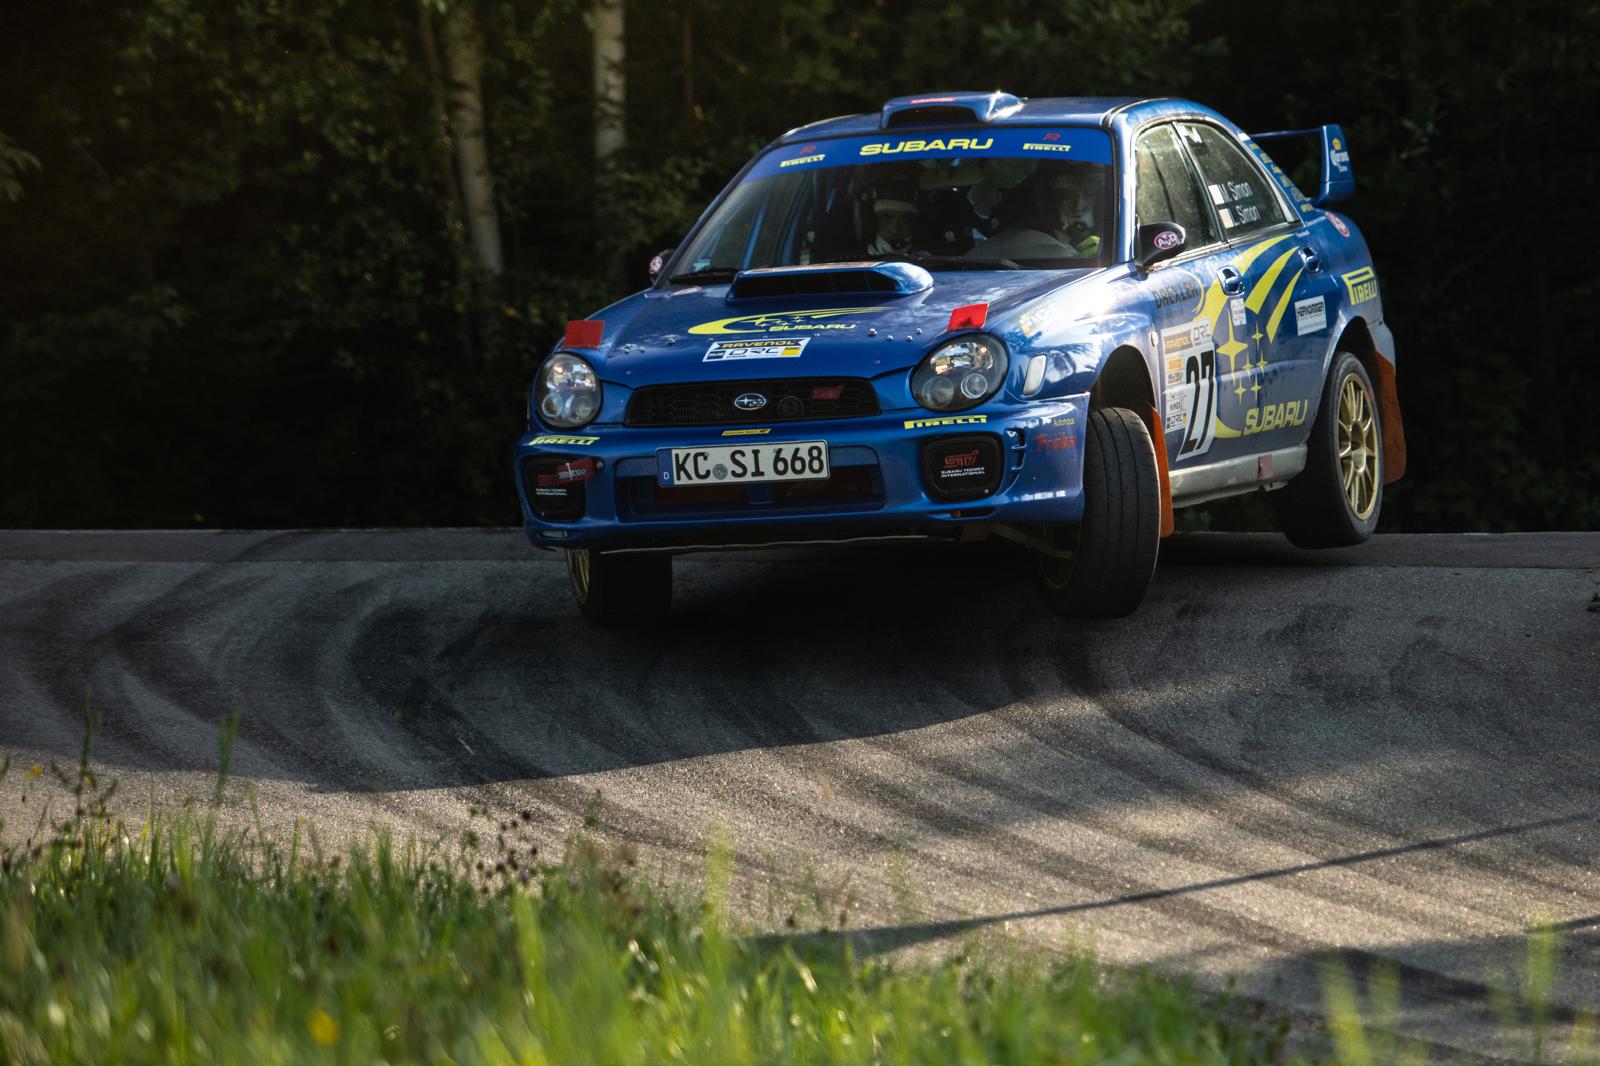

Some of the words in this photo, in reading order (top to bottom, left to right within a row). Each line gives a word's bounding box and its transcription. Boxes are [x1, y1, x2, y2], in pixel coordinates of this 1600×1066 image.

[860, 138, 993, 156] SUBARU
[1228, 181, 1253, 200] Simon
[1236, 205, 1261, 224] Simon
[769, 324, 857, 332] SUBARU
[722, 340, 797, 349] RAVENOL
[1180, 349, 1215, 456] 27
[904, 415, 987, 430] PIRELLI
[1245, 399, 1308, 433] SUBARU
[528, 435, 600, 446] PIRELLI
[663, 471, 670, 480] D
[675, 452, 711, 481] KC
[730, 449, 765, 479] SI
[772, 446, 825, 476] 668
